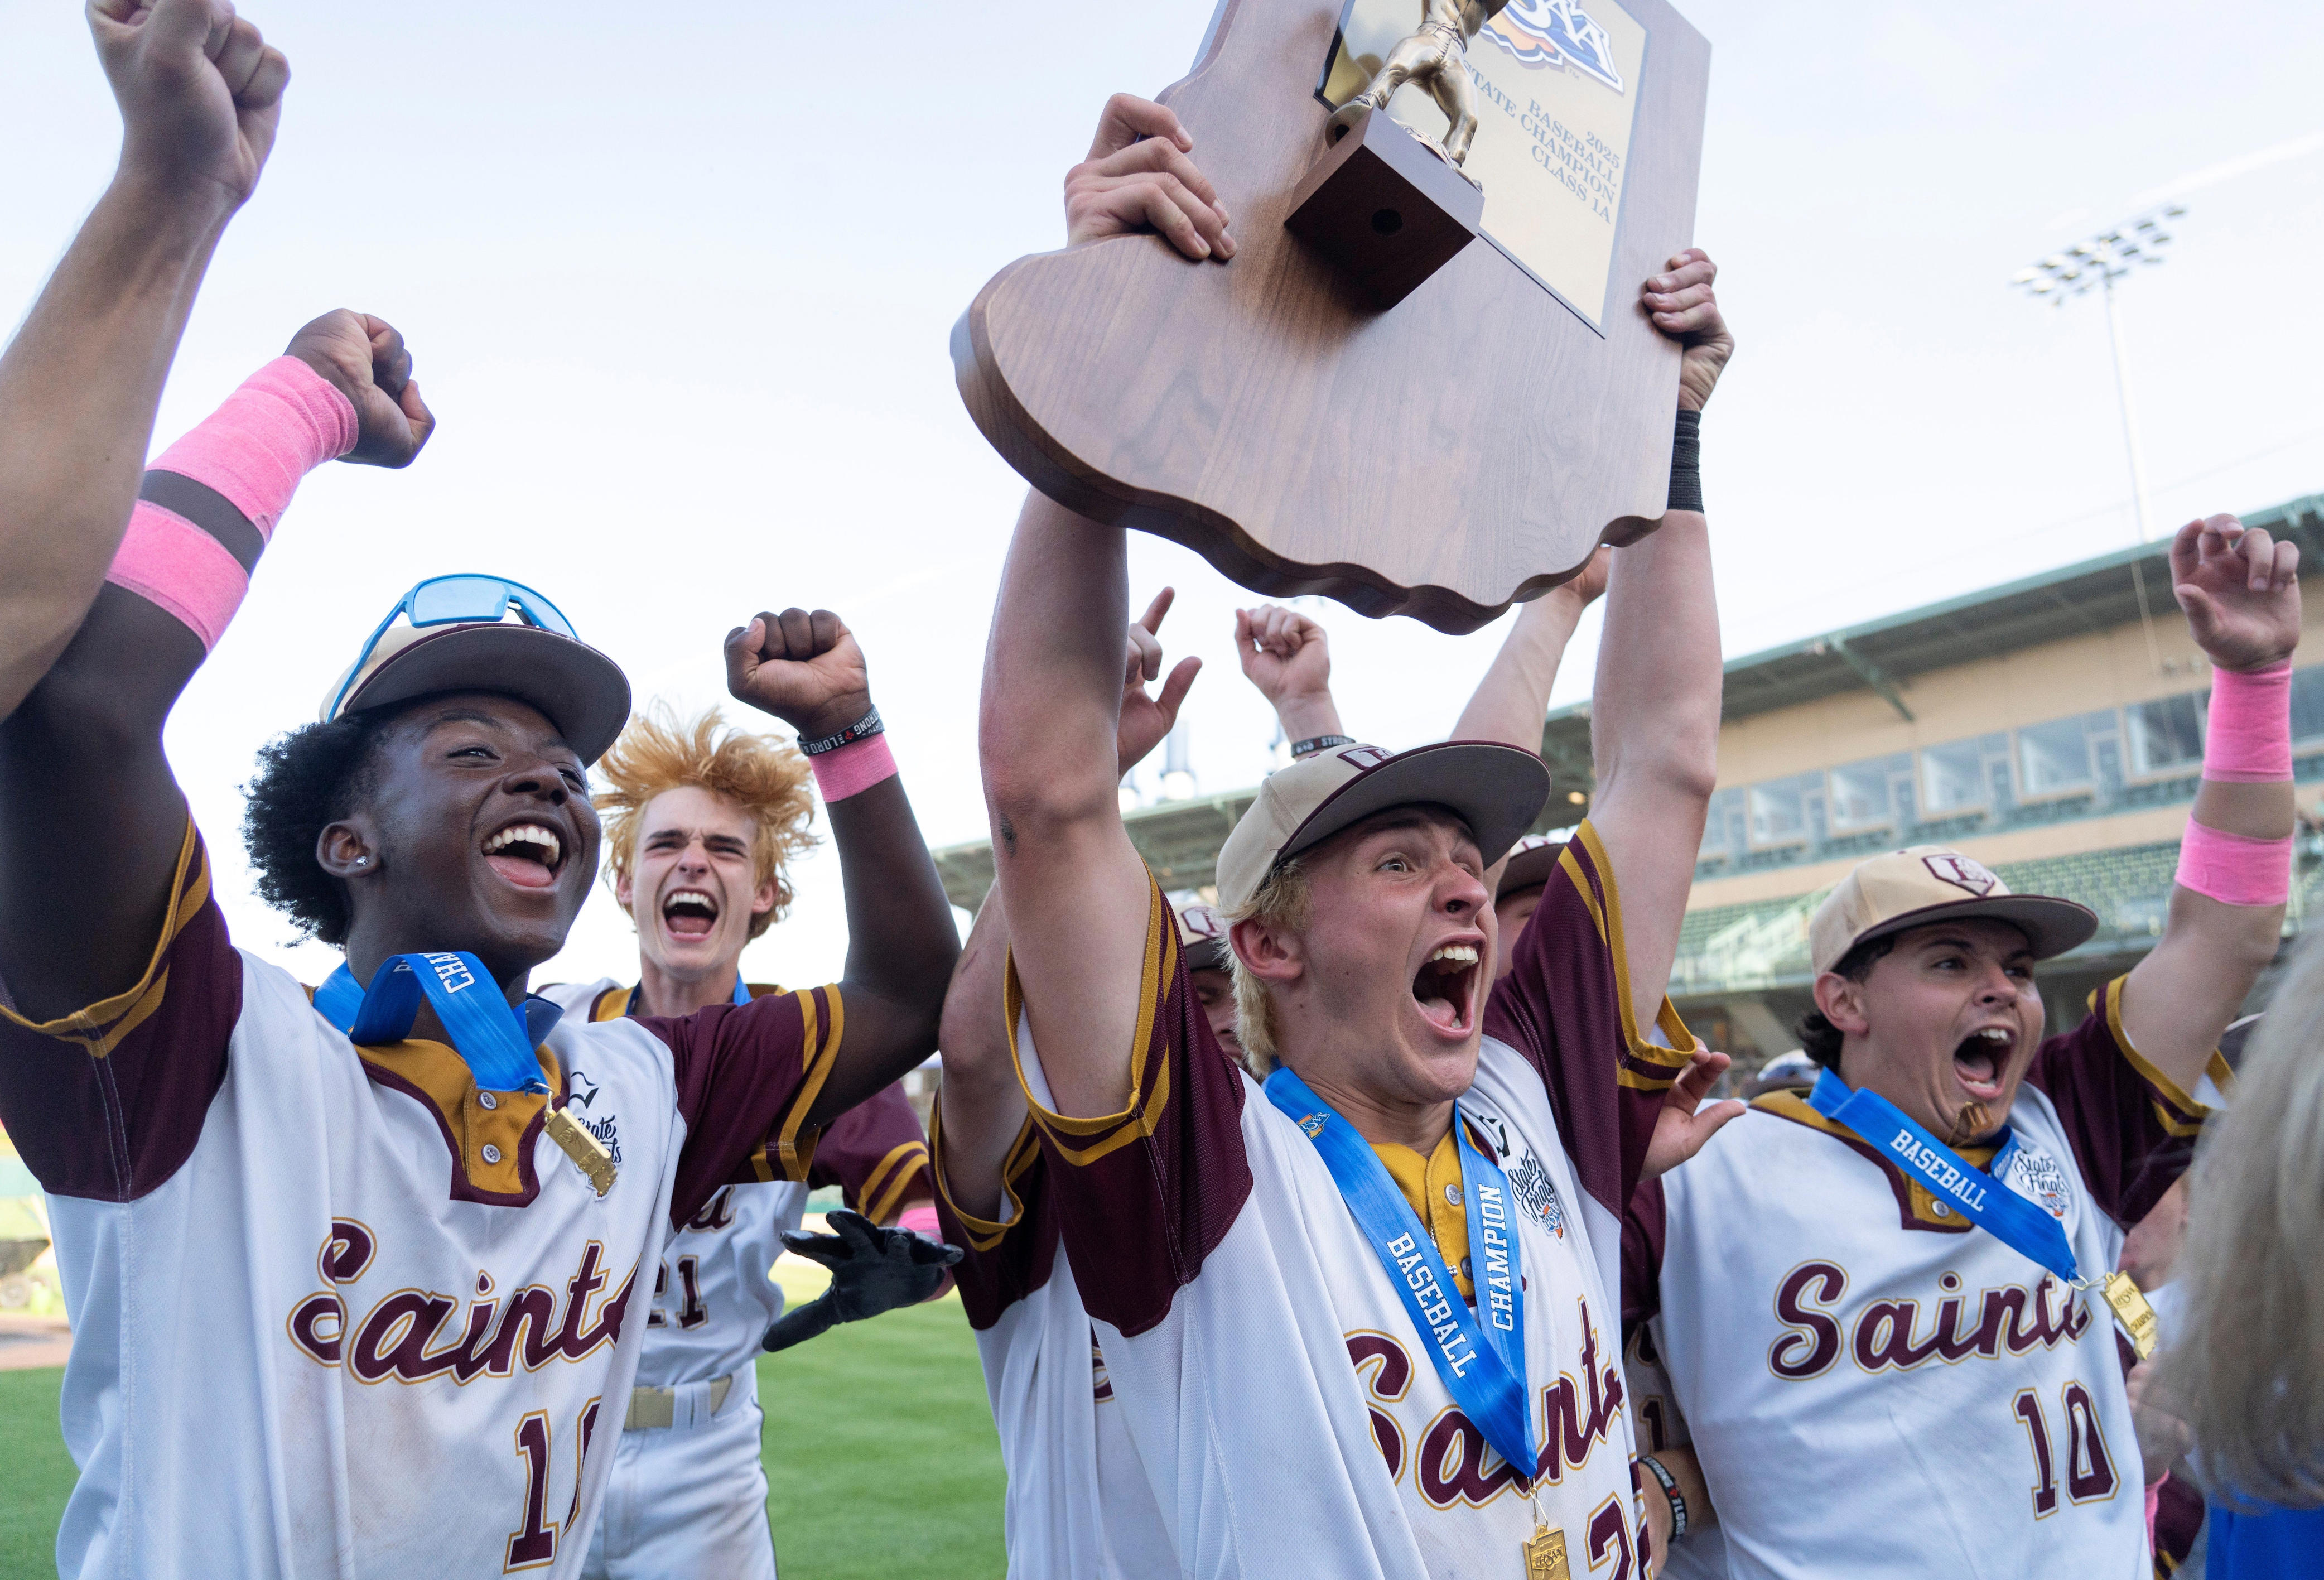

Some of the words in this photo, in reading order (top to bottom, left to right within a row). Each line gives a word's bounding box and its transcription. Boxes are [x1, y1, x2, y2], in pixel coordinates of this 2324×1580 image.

[1521, 113, 1616, 204] CHAMPION
[1528, 98, 1617, 187] BASEBALL
[1586, 131, 1620, 169] 2025
[1531, 145, 1587, 201] CLASS
[1592, 198, 1611, 224] 1A
[809, 736, 838, 753] LORD
[1508, 1147, 1536, 1201] State
[1521, 1169, 1555, 1222] Finals
[1889, 1128, 1987, 1212] BASEBALL
[2014, 1154, 2056, 1173] State
[1478, 1182, 1514, 1332] CHAMPION
[1386, 1230, 1477, 1379] BASEBALL
[2012, 1380, 2120, 1520] 10
